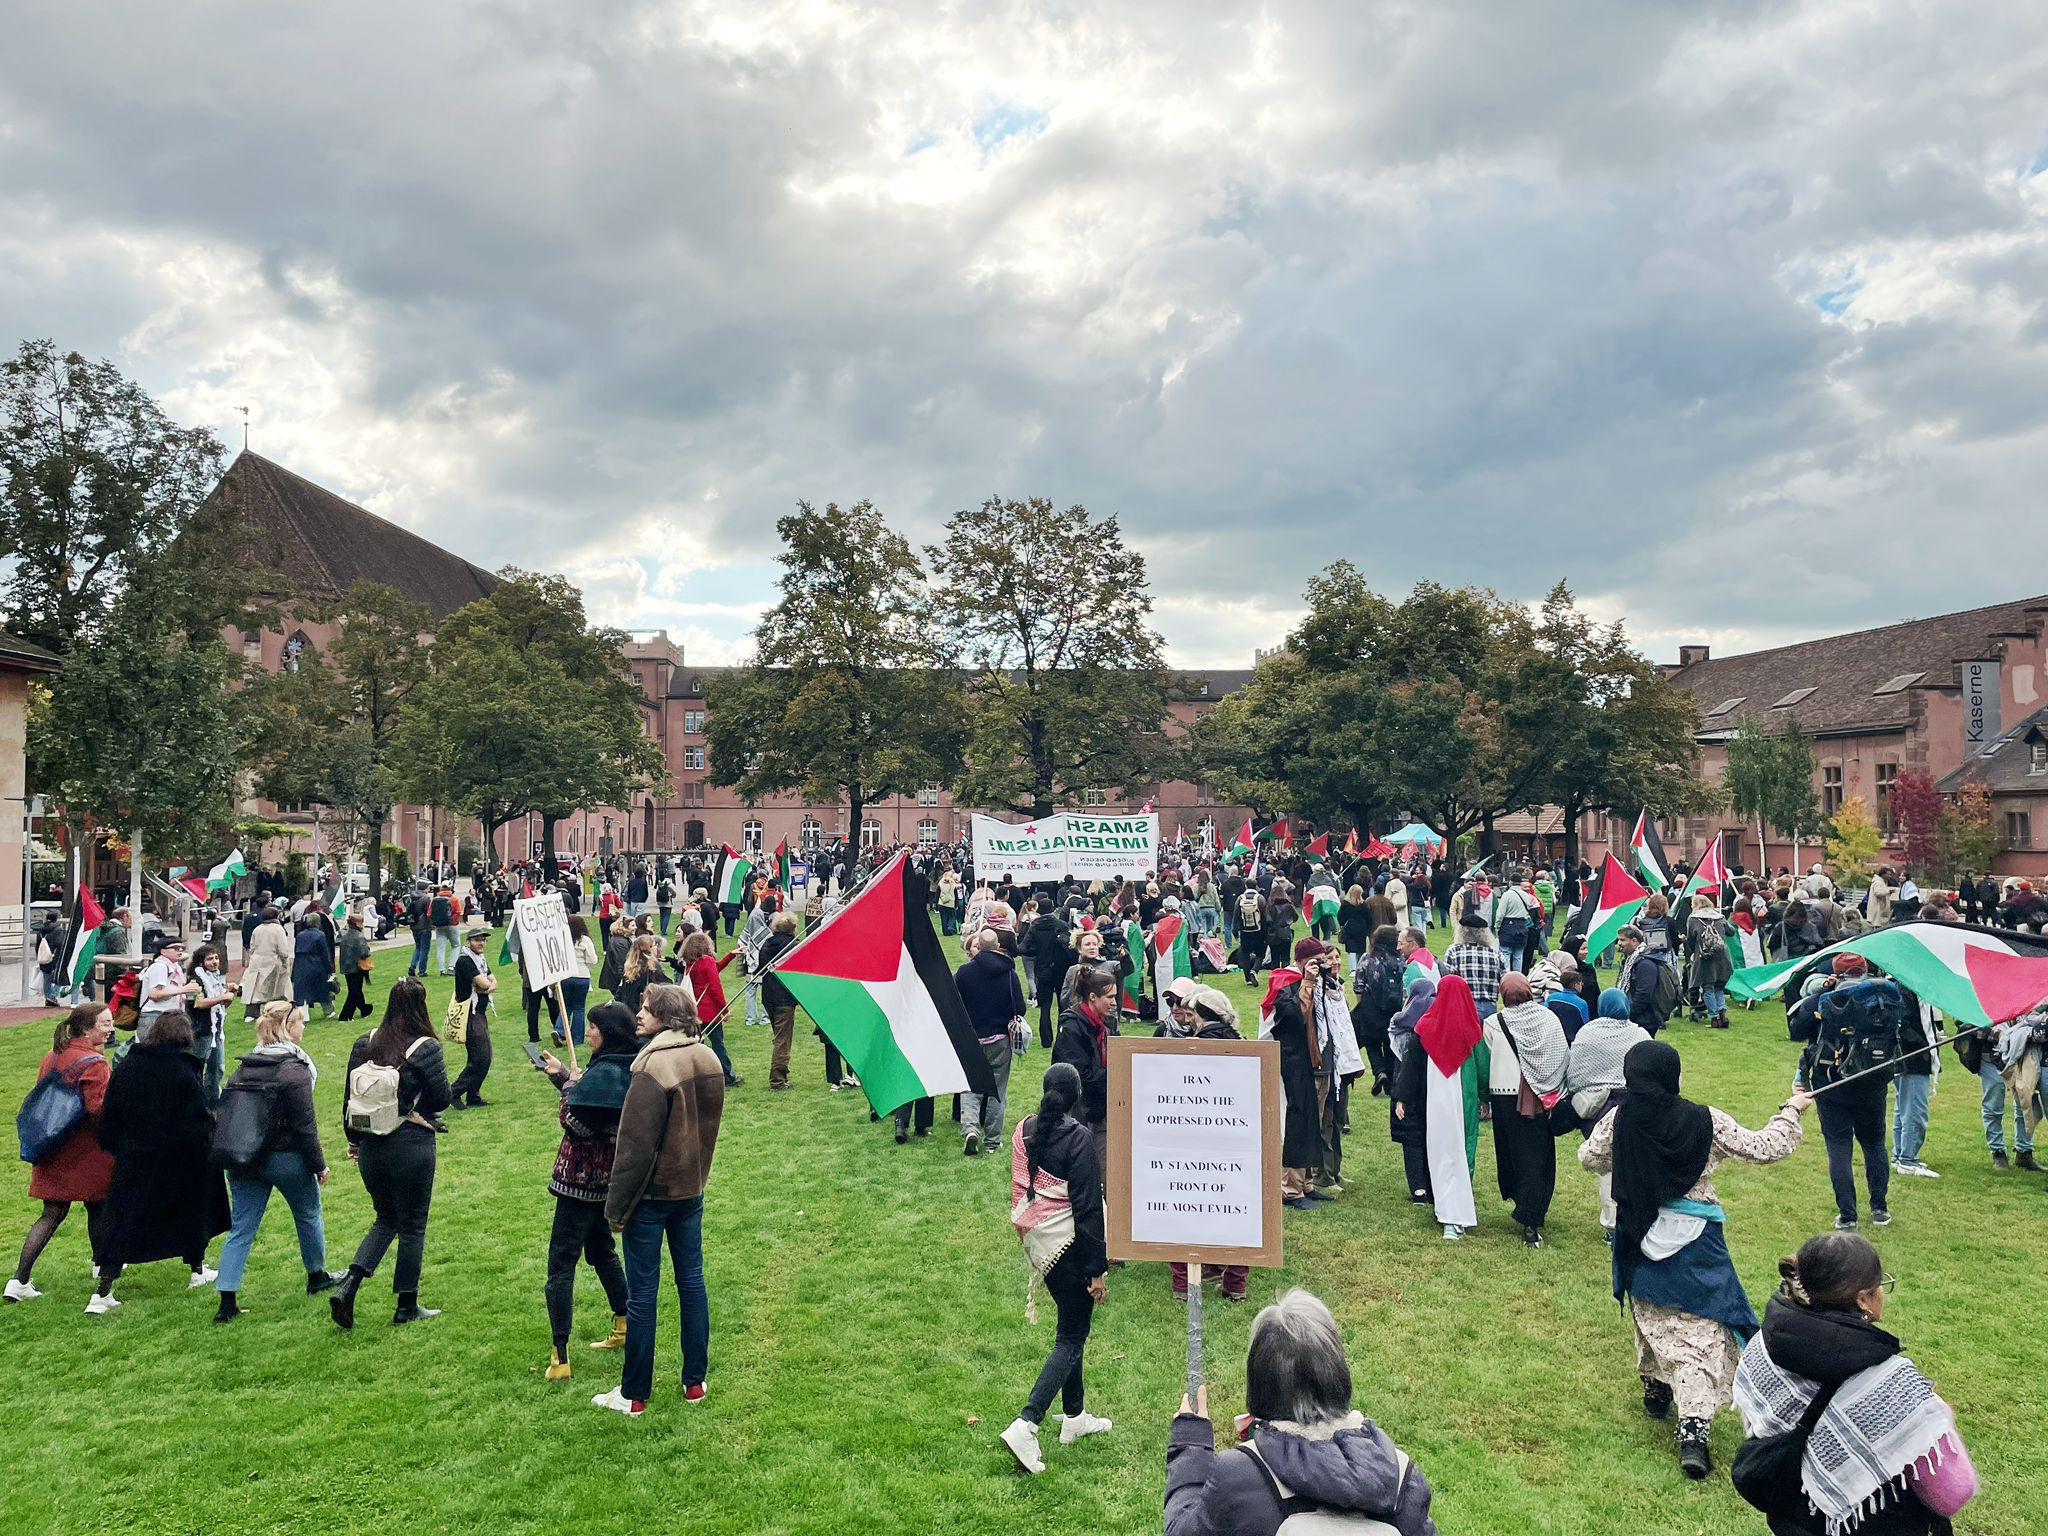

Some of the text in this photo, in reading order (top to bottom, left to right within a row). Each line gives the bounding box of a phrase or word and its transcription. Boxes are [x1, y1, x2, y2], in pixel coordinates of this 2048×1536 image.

[1967, 664, 1984, 743] Kaserne
[1183, 1075, 1211, 1085] IRAN
[1157, 1095, 1235, 1106] DEFENDS THE
[1147, 1115, 1212, 1126] OPPRESSED
[1151, 1160, 1242, 1172] BY STANDING IN
[1169, 1181, 1226, 1193] FRONT OF
[1147, 1201, 1169, 1211] THE
[1172, 1202, 1204, 1213] MOST
[1208, 1204, 1241, 1214] EVILS
